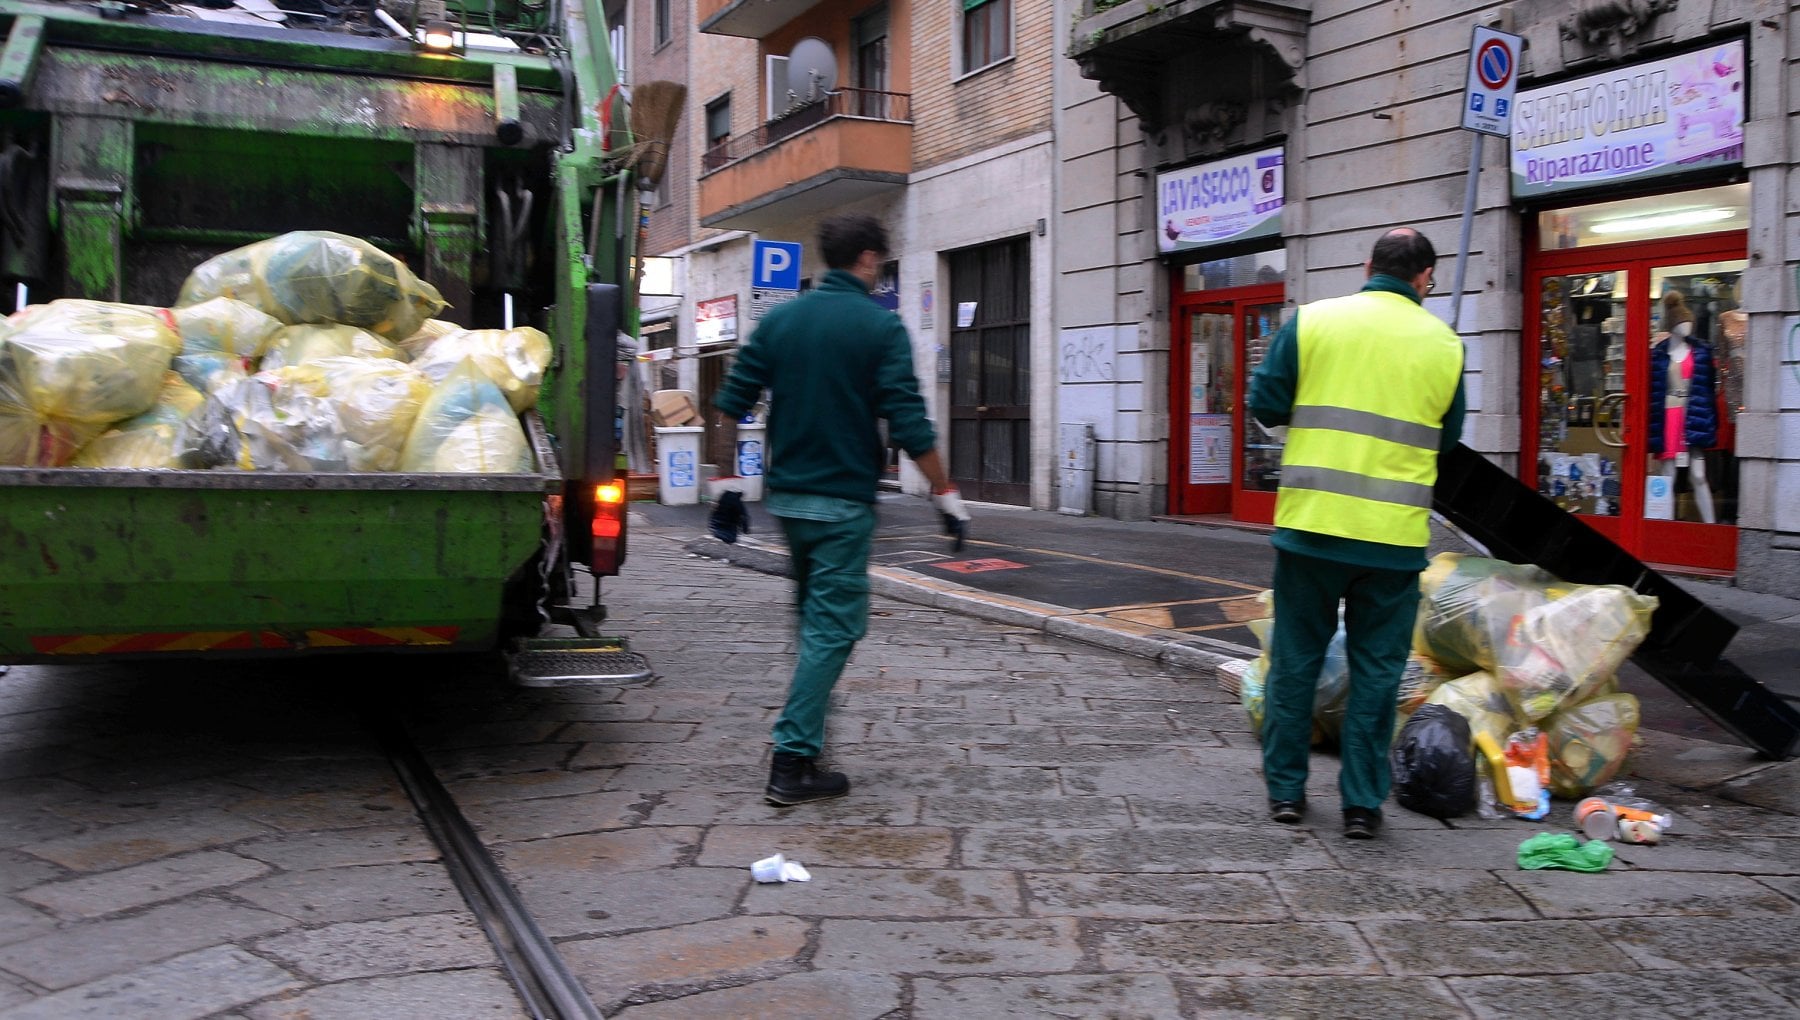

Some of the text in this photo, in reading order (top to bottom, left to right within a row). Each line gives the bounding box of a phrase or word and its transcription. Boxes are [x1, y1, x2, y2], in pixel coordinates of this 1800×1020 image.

[1516, 70, 1668, 151] SARTORIA
[1526, 142, 1654, 184] Riparazione
[1163, 166, 1250, 215] LAVASECCO
[762, 247, 792, 282] P
